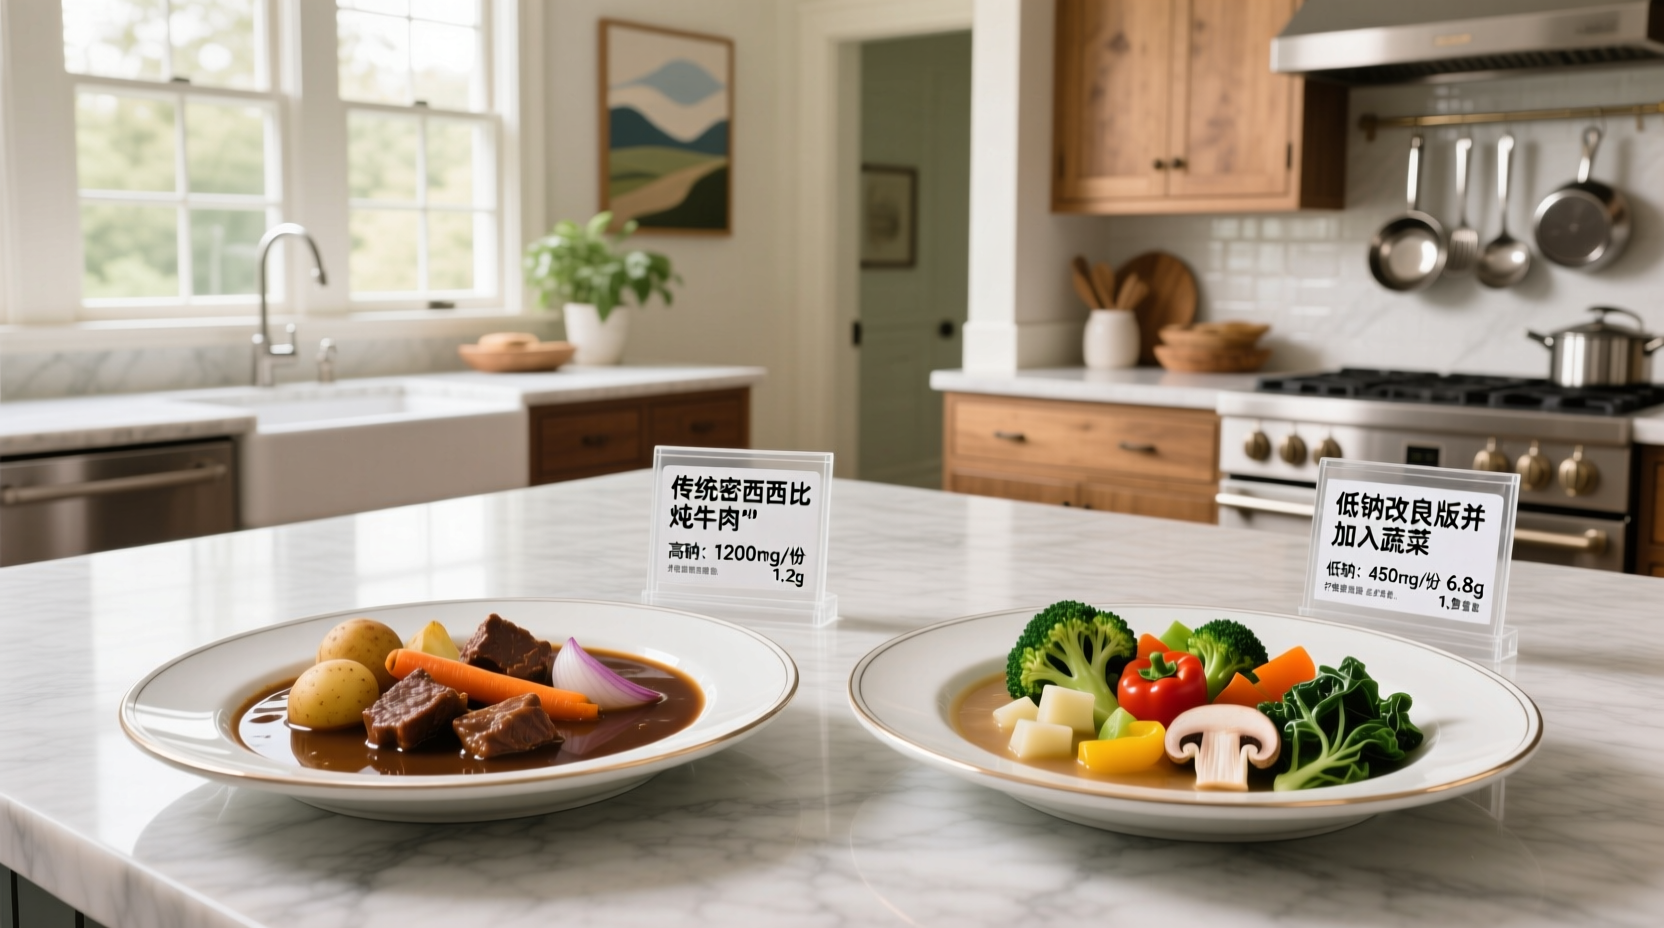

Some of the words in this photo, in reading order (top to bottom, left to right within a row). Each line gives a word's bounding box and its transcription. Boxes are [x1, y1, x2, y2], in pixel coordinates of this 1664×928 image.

[1336, 491, 1486, 531] 低钠改良版并
[1331, 520, 1432, 556] 加入蔬菜
[773, 568, 804, 588] 1.2g
[1446, 574, 1485, 600] 6.8g
